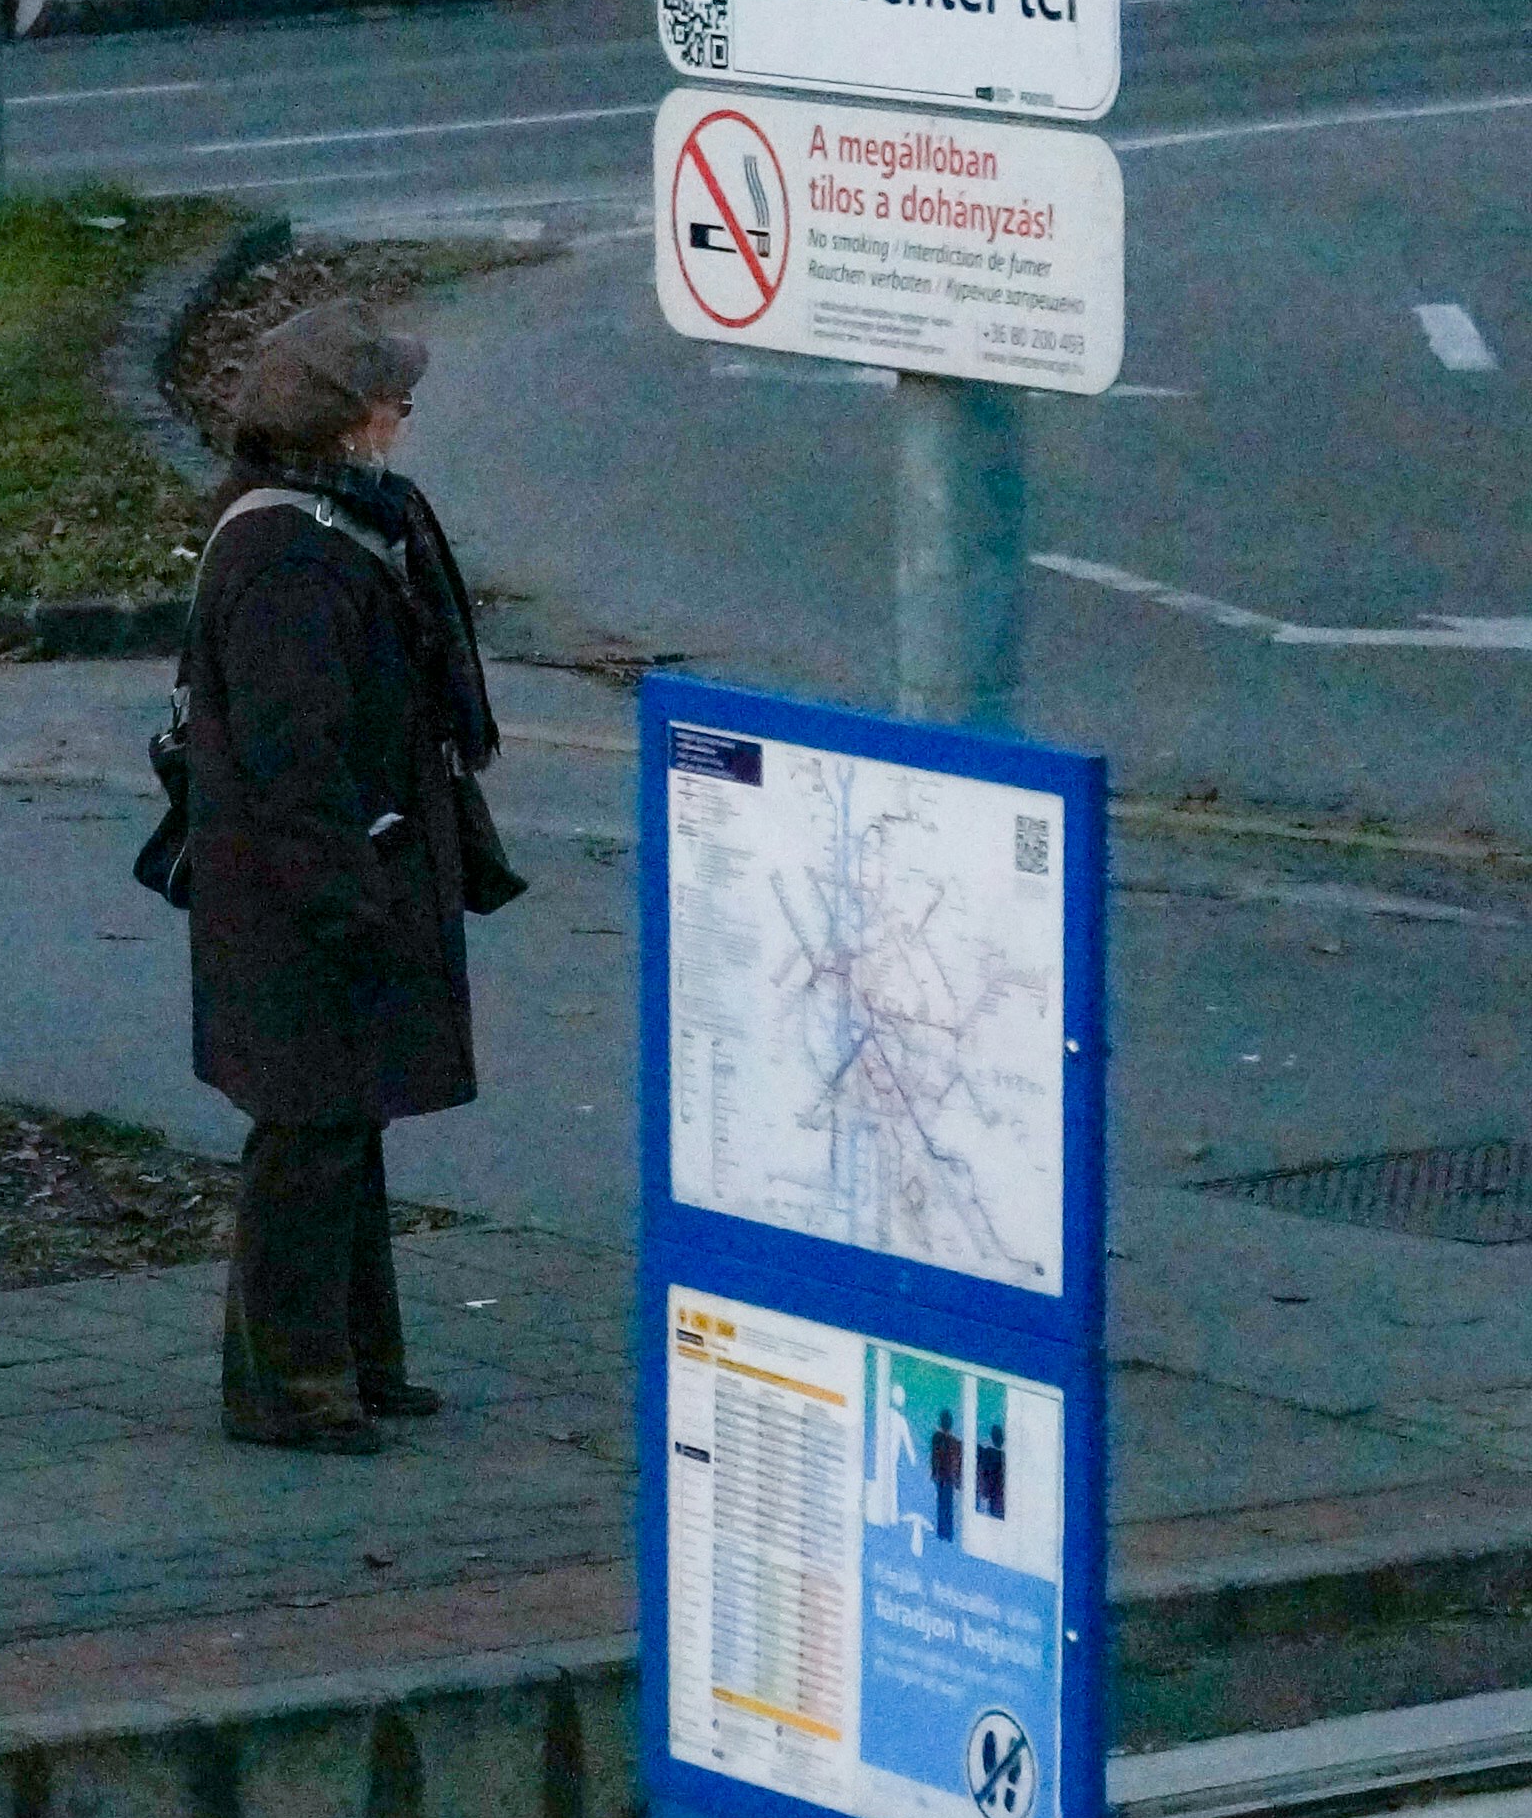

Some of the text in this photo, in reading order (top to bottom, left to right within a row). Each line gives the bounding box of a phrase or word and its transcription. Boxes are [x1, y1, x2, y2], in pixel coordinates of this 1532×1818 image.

[808, 125, 997, 179] A megállóban
[809, 174, 1054, 243] tilos a dohányzás!
[808, 228, 827, 248] No
[832, 235, 889, 262] smoking
[988, 253, 1006, 272] de
[1007, 252, 1052, 279] fumer
[808, 259, 865, 285] Rauchen
[871, 269, 932, 294] verboten
